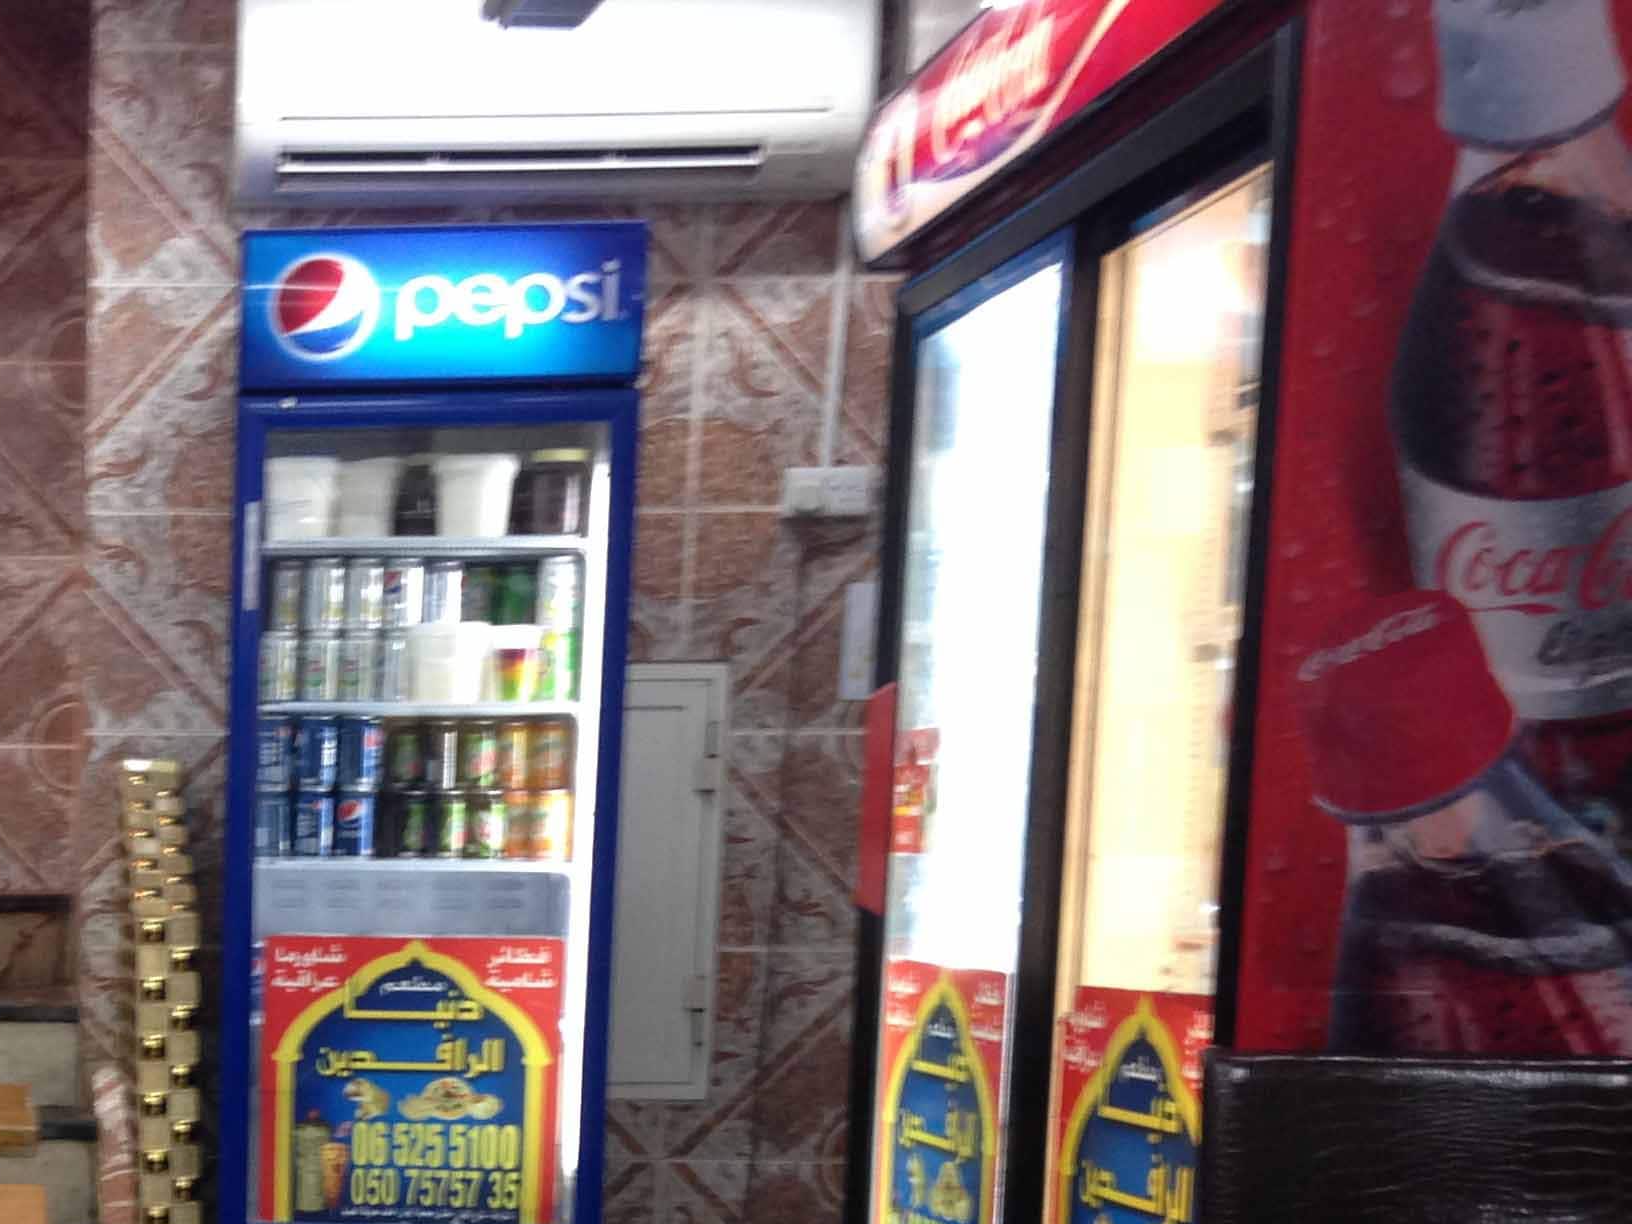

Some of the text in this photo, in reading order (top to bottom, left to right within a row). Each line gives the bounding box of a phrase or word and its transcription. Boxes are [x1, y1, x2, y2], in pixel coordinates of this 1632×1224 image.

[394, 259, 624, 341] pepsi
[352, 1121, 520, 1170] 06 525 5100
[351, 1168, 399, 1205] 050
